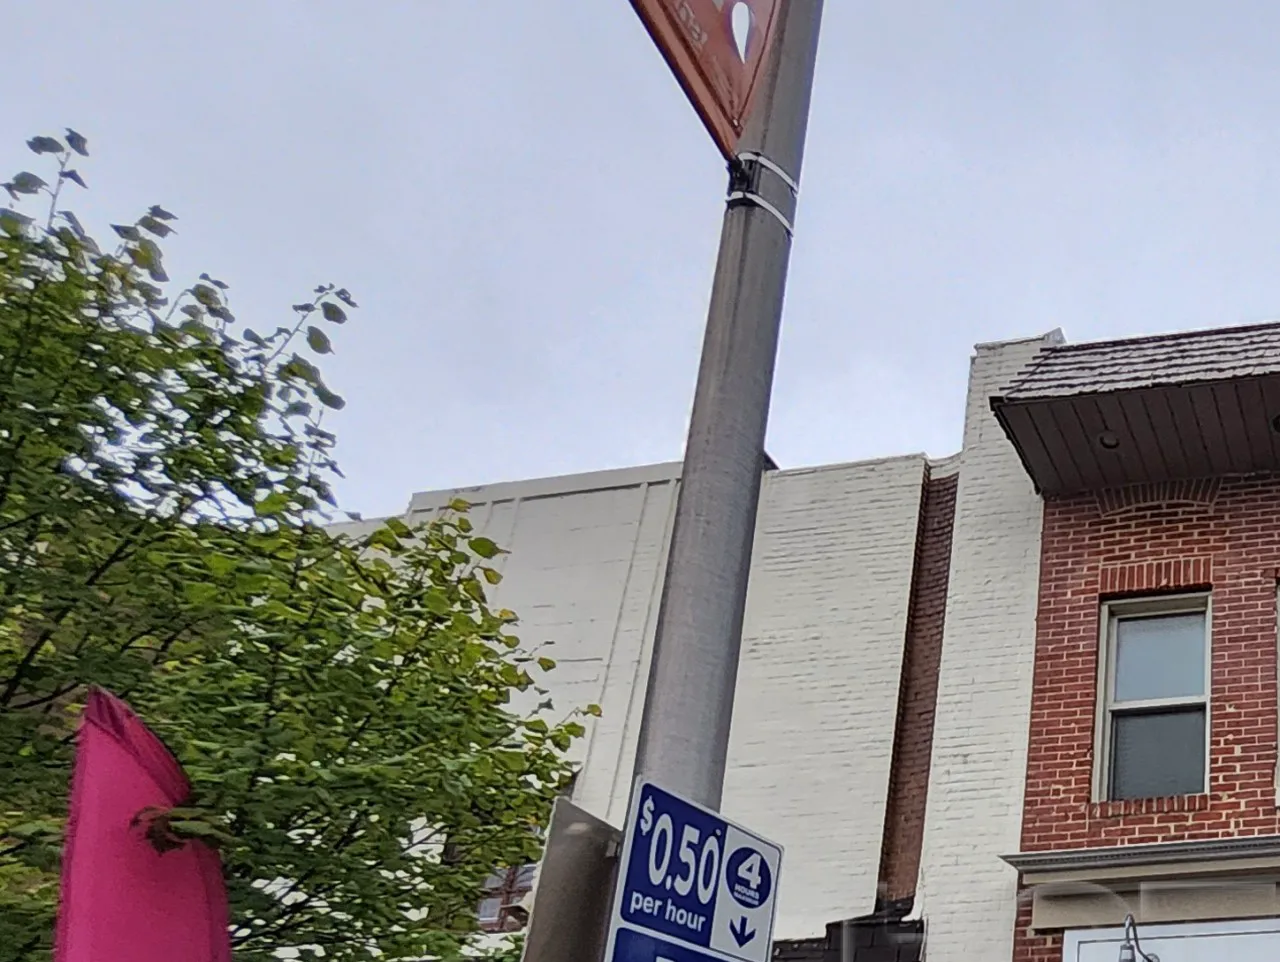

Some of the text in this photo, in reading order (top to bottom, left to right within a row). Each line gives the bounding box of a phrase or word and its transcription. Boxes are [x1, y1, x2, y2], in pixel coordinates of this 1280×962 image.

[639, 795, 720, 905] $0.50
[737, 852, 762, 890] 4
[629, 890, 662, 914] per
[664, 899, 707, 932] hour
